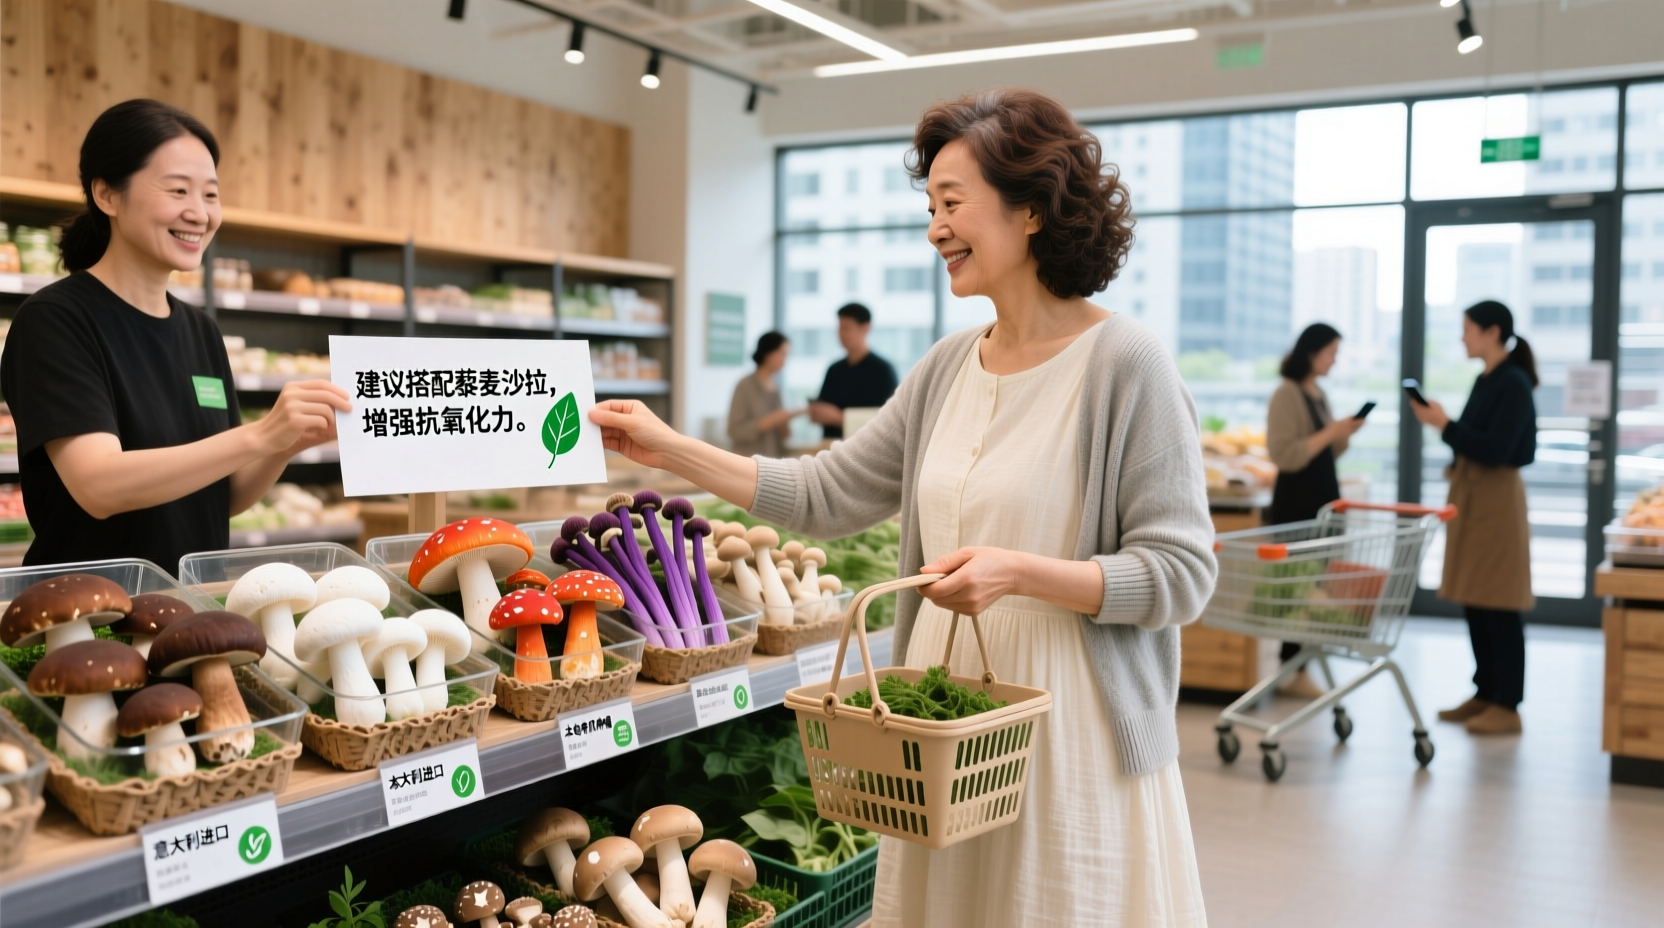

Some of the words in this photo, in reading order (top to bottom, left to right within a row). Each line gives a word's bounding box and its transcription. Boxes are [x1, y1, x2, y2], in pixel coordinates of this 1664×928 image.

[362, 405, 526, 438] 增强抗氧化力。
